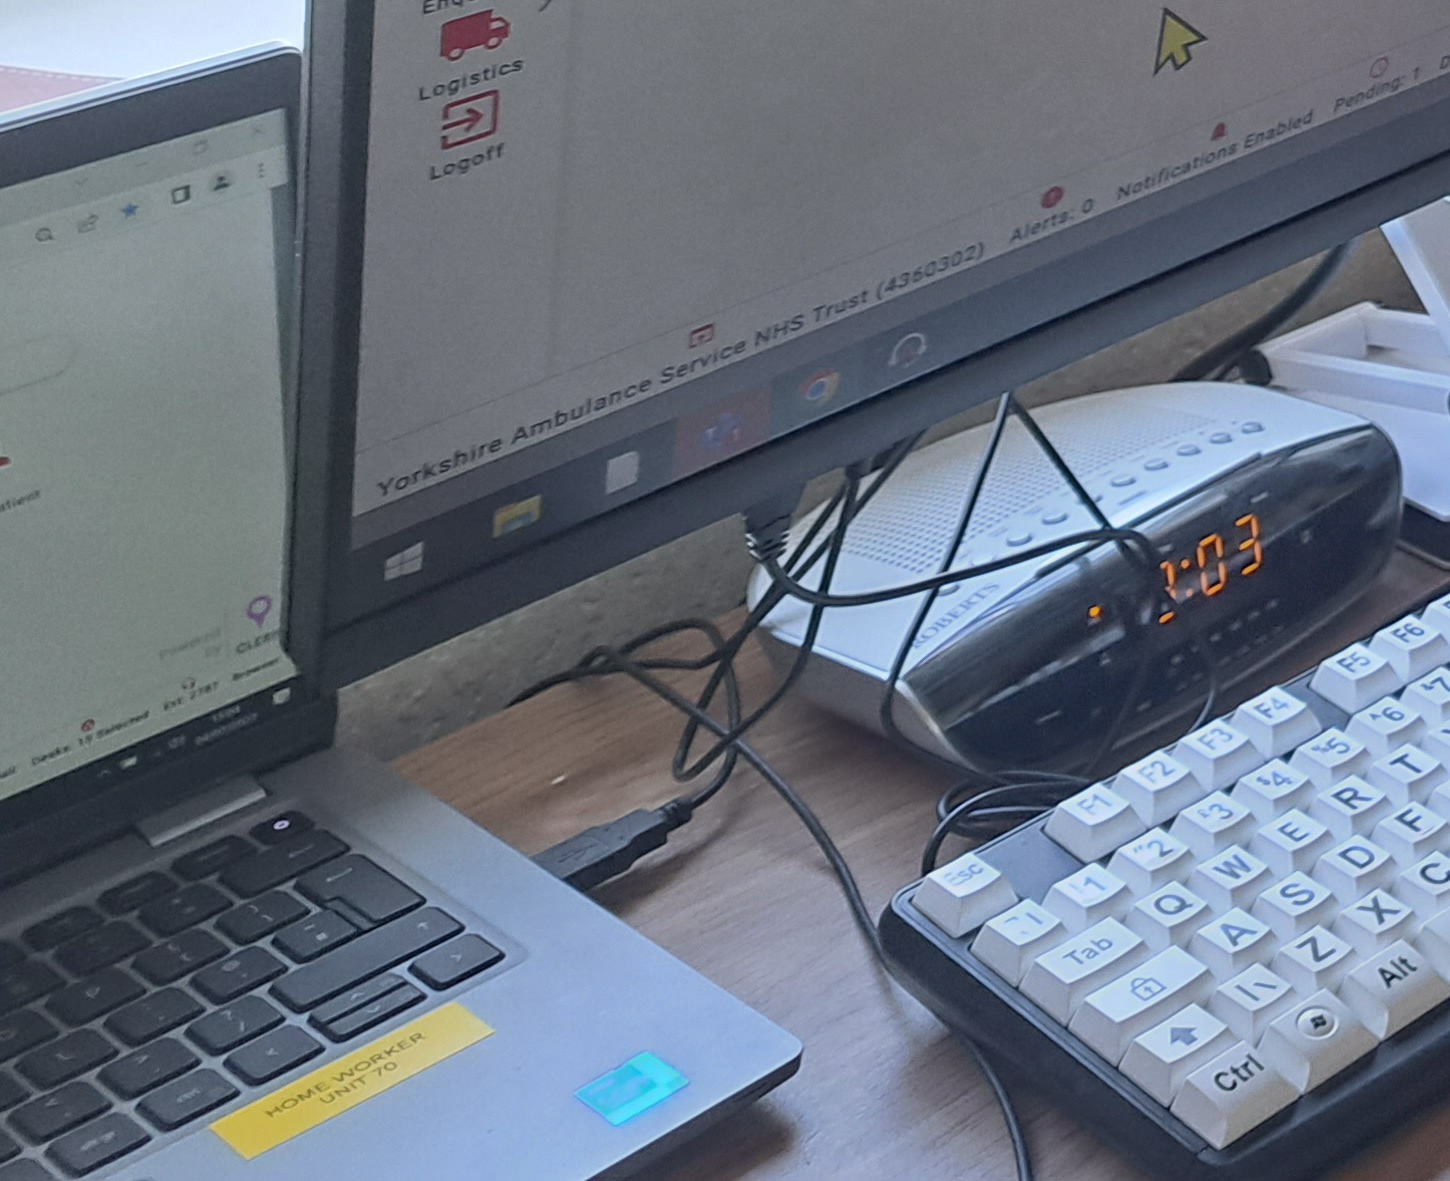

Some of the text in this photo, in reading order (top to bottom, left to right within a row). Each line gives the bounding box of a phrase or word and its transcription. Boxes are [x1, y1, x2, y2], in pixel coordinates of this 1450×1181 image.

[418, 59, 524, 101] Logistics
[1333, 77, 1404, 113] Pending:
[429, 142, 505, 181] Logoff
[1116, 109, 1315, 201] Notifications Enabled
[1010, 198, 1095, 243] Alerts: 0
[376, 437, 505, 499] Yorkshire
[510, 376, 652, 447] Ambulance
[659, 336, 746, 387] Service
[753, 313, 805, 348] NHS
[812, 287, 870, 323] Trust
[1390, 622, 1425, 644] F6
[1335, 652, 1372, 674] F5
[1253, 697, 1290, 719] F4
[1196, 728, 1234, 751] F3
[1138, 760, 1175, 784] F2
[1389, 753, 1423, 775] T
[1077, 794, 1114, 816] F1
[1330, 787, 1373, 810] R
[1277, 821, 1311, 843] E
[1398, 808, 1427, 833] F
[1212, 854, 1253, 880] W
[1337, 845, 1376, 870] D
[942, 862, 985, 886] Esc
[1153, 894, 1193, 917] Q
[1279, 882, 1316, 906] S
[1356, 896, 1400, 925] X
[1219, 923, 1258, 947] A
[1062, 934, 1114, 968] Tab
[1295, 936, 1337, 963] Z
[1376, 954, 1419, 990] Alt
[264, 1031, 427, 1119] HOME WORKER
[319, 1059, 399, 1106] UNIT 70
[1214, 1052, 1266, 1093] Ctrl
